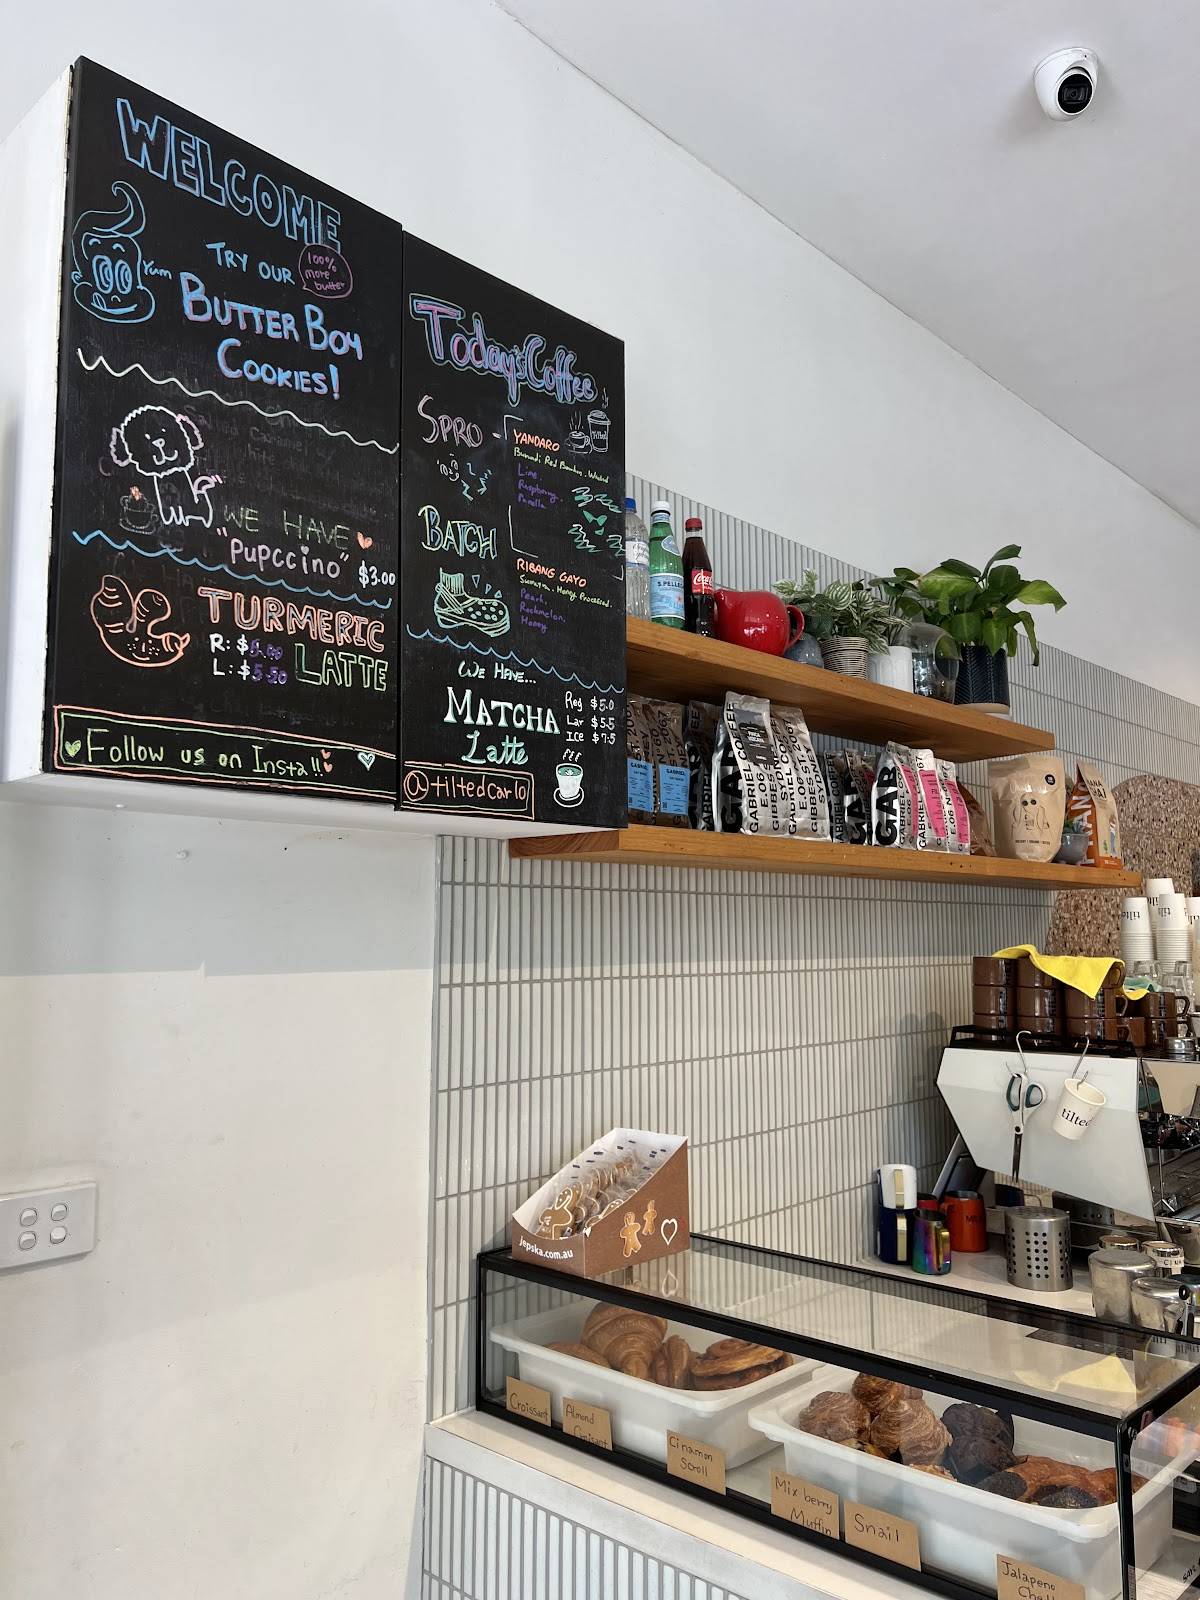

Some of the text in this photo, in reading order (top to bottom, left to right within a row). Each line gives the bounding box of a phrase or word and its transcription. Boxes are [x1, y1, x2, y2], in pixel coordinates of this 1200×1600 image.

[116, 97, 341, 253] WELCOME
[142, 259, 173, 280] Yum
[206, 242, 295, 285] TRY OUR
[305, 269, 330, 280] more
[307, 252, 337, 273] 100%
[314, 281, 345, 291] butter
[180, 272, 299, 342] BUTTER
[412, 297, 596, 403] Today's Coffee
[217, 337, 339, 400] COOKIES!
[417, 394, 483, 448] SPRO
[513, 428, 560, 452] YANDARO
[545, 455, 557, 467] Red
[224, 505, 350, 550] WE HAVE
[418, 504, 497, 560] BATCH
[357, 560, 396, 588] $3.00
[516, 558, 587, 588] RIBANG GAYO
[198, 586, 385, 653] TURMERIC
[209, 633, 231, 654] R:
[212, 658, 234, 677] L:
[295, 643, 388, 691] LATTE
[444, 686, 560, 735] MATCHA
[565, 690, 615, 712] Reg $5.0
[566, 715, 615, 731] Lar $5.5
[592, 731, 616, 745] $7.5
[657, 710, 673, 745] 2067
[725, 703, 748, 761] COFFEE
[87, 728, 163, 762] Follow
[181, 748, 206, 766] us
[219, 754, 242, 769] on
[462, 730, 528, 765] Latte
[403, 770, 527, 802] @tiltedcarlo
[756, 772, 769, 808] E.06
[783, 719, 818, 833] GIBBES ST. 2067
[803, 745, 826, 804] SYDNEY
[743, 764, 759, 834] GABRIEL
[766, 773, 780, 831] GIBBES
[796, 777, 808, 810] E.06
[875, 766, 898, 846] GAB
[833, 799, 845, 844] ABRIEL
[898, 791, 906, 845] GABRIEL
[917, 799, 927, 848] GABRIEL
[948, 809, 957, 835] E.06
[566, 1404, 595, 1425] Almond
[680, 1457, 708, 1477] Scroll
[775, 1476, 833, 1515] Mix berry
[790, 1507, 832, 1537] Muffin
[854, 1513, 899, 1542] Snail
[1001, 1560, 1056, 1591] Jalapeno
